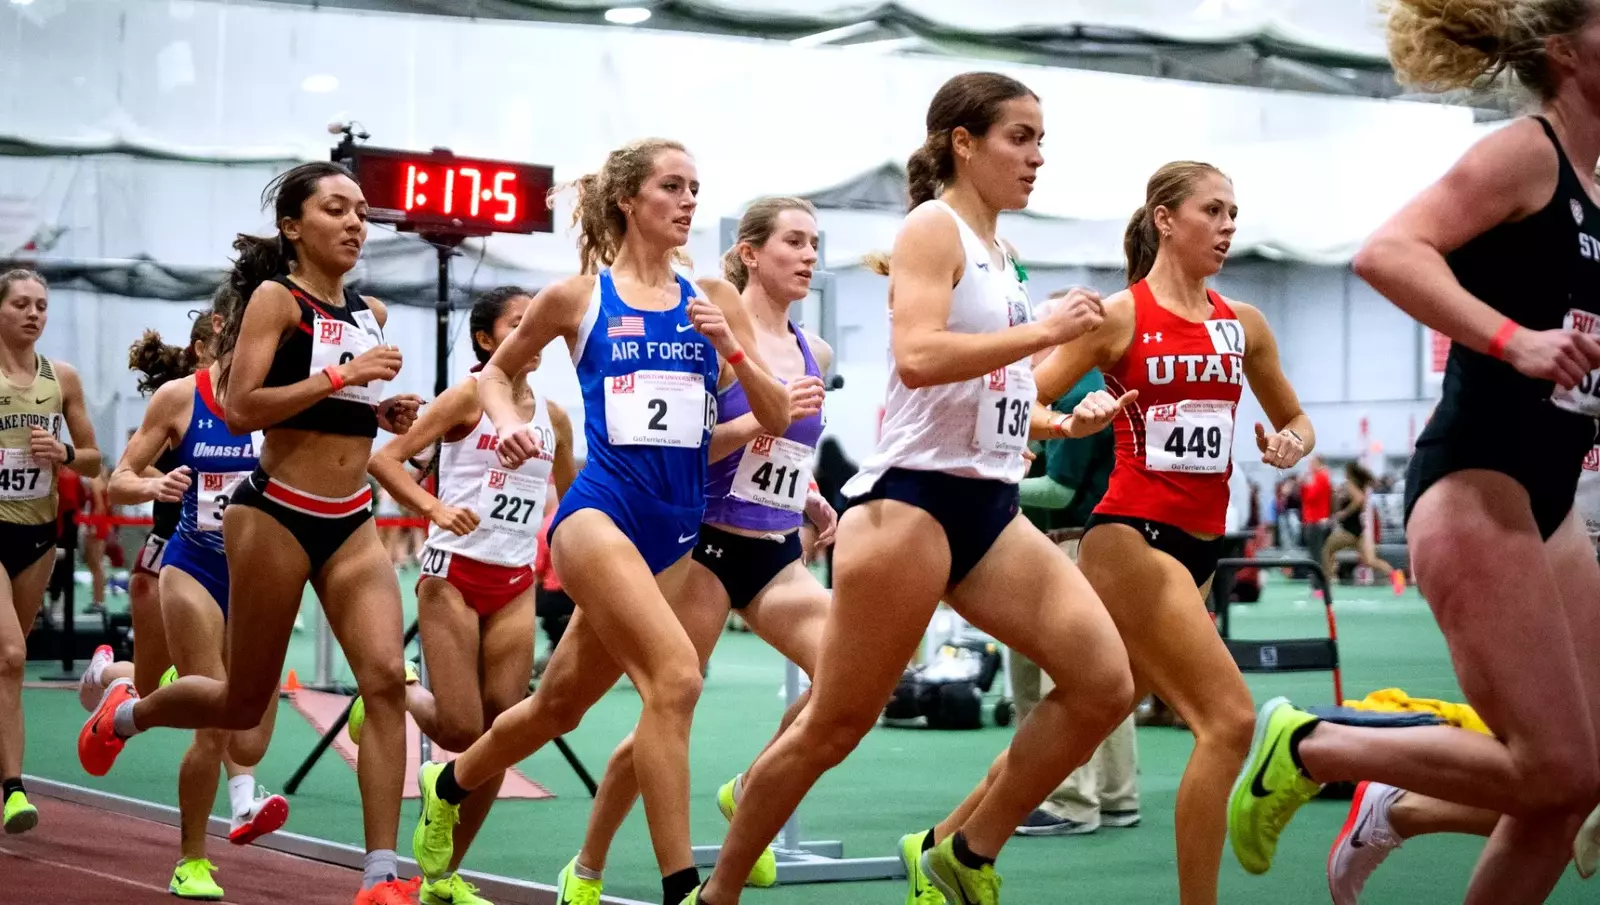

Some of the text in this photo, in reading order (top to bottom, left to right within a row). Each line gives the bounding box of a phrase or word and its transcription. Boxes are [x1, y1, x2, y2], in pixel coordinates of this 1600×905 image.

[321, 322, 343, 341] BU
[1215, 321, 1242, 353] 12
[612, 341, 704, 361] AIR FORCE
[1146, 354, 1243, 386] UTAH
[647, 399, 668, 431] 2
[995, 397, 1030, 438] 136
[633, 436, 681, 445] GoTerriers.com
[1164, 426, 1222, 458] 449
[0, 468, 41, 491] 457
[751, 461, 799, 499] 411
[1171, 463, 1217, 471] GoTerriers.com
[490, 494, 536, 525] 227
[423, 549, 446, 574] 20
